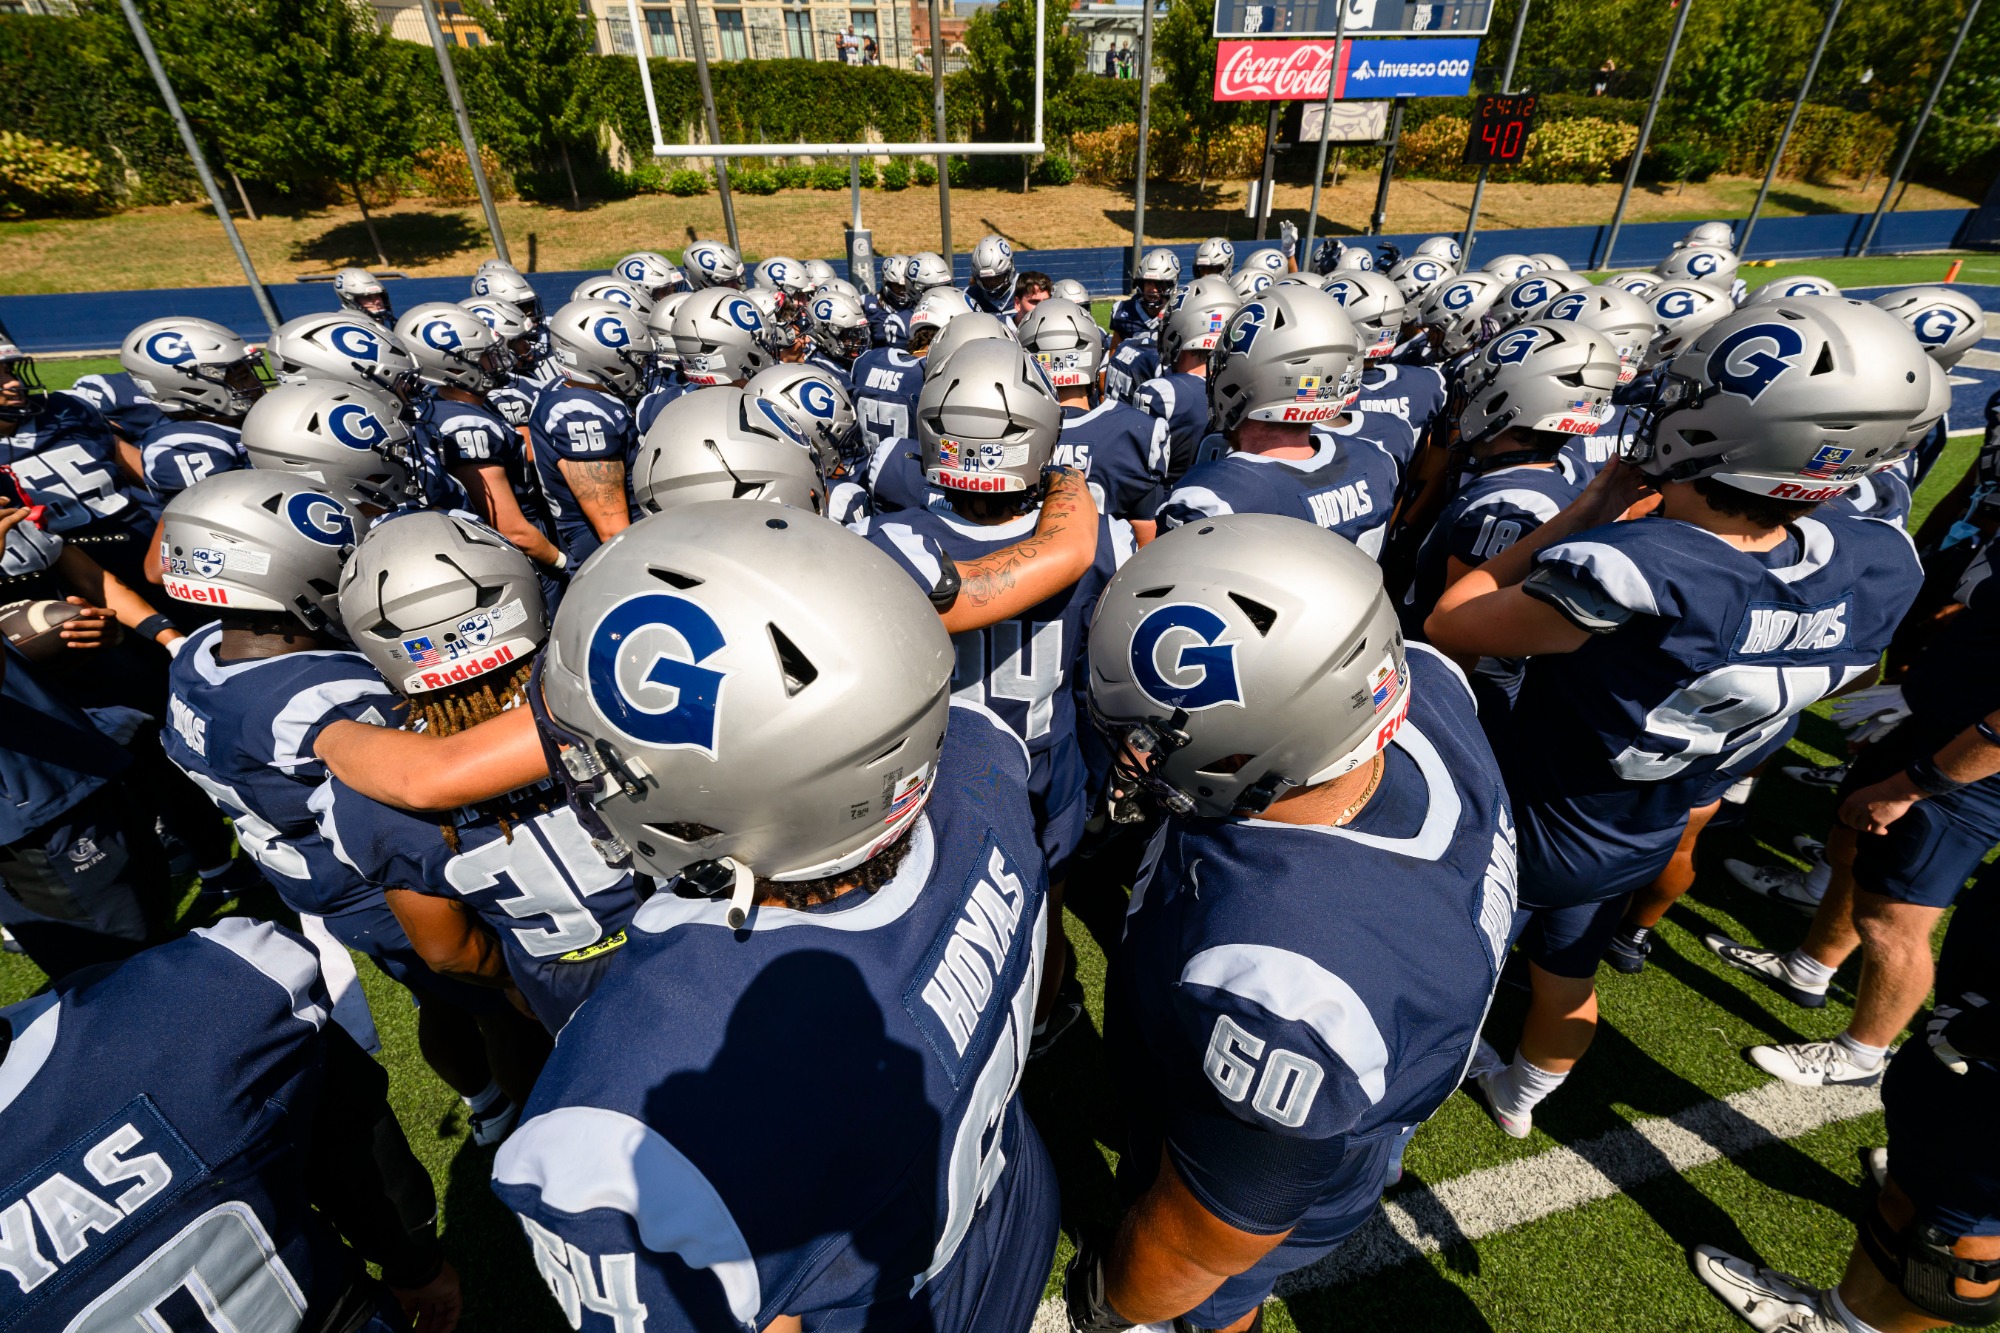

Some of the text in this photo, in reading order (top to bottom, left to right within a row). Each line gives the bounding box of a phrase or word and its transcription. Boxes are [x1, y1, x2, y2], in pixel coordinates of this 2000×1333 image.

[1246, 5, 1263, 15] TIME
[1243, 23, 1260, 33] LEFT
[1378, 59, 1469, 78] Invesco QQQ
[1482, 97, 1535, 118] 24:12
[1481, 121, 1524, 158] 40
[624, 260, 645, 281] G
[698, 250, 718, 271] G
[767, 262, 788, 281] G
[906, 258, 920, 280] G
[1265, 254, 1282, 269] G
[1413, 262, 1437, 282] G
[1687, 253, 1717, 276] G
[474, 277, 490, 296] G
[1442, 284, 1475, 310] G
[1510, 279, 1549, 310] G
[729, 299, 764, 332] G
[814, 299, 833, 321] G
[910, 312, 928, 325] dell
[1542, 293, 1590, 323] G
[1655, 290, 1694, 319] G
[422, 319, 464, 352] G
[593, 316, 633, 349] G
[1223, 302, 1267, 359] G
[1913, 308, 1958, 347] G
[145, 331, 198, 365] G
[330, 325, 380, 363] G
[1369, 346, 1395, 357] Ridd
[1485, 327, 1542, 366] G
[1705, 322, 1807, 407] G
[686, 376, 717, 385] ddell
[1051, 374, 1079, 386] ddell
[798, 380, 838, 420] G
[1283, 405, 1342, 421] Riddell
[328, 402, 392, 452] G
[567, 420, 606, 451] 56
[455, 430, 491, 459] 90
[1050, 444, 1088, 470] YAS
[174, 452, 215, 488] 12
[963, 457, 980, 472] 84
[939, 471, 1006, 491] Riddell
[1768, 482, 1848, 500] Ridd
[1307, 480, 1373, 528] HOYAS
[285, 491, 358, 548] G
[1471, 515, 1522, 559] 18
[172, 558, 189, 575] 22
[1739, 602, 1847, 654] HOYAS
[421, 645, 514, 689] Riddell
[1128, 601, 1246, 713] G
[584, 589, 738, 762] G
[922, 846, 1024, 1058] HOYAS
[1203, 1014, 1325, 1128] 60
[0, 1122, 173, 1294] YAS
